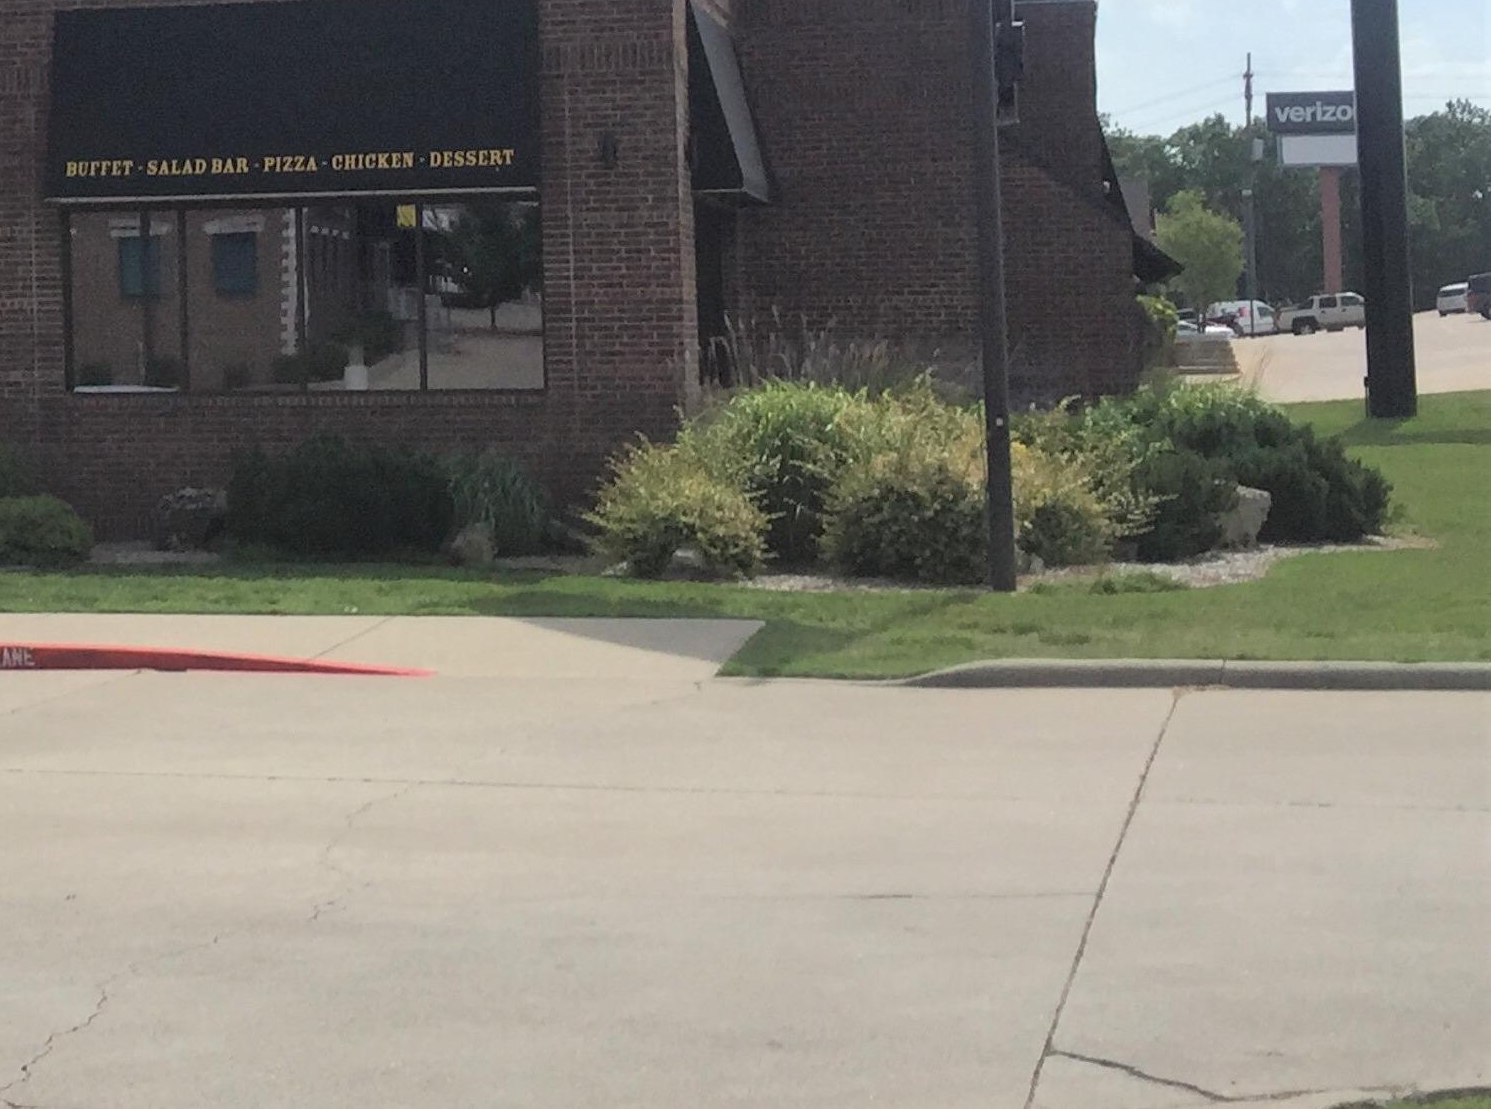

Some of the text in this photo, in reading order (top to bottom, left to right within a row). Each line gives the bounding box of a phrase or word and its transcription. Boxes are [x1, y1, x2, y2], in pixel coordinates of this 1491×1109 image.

[1274, 101, 1353, 123] verizo
[66, 149, 515, 177] BUFFET SALAD BAR PIZZA CHICKEN DESSERT
